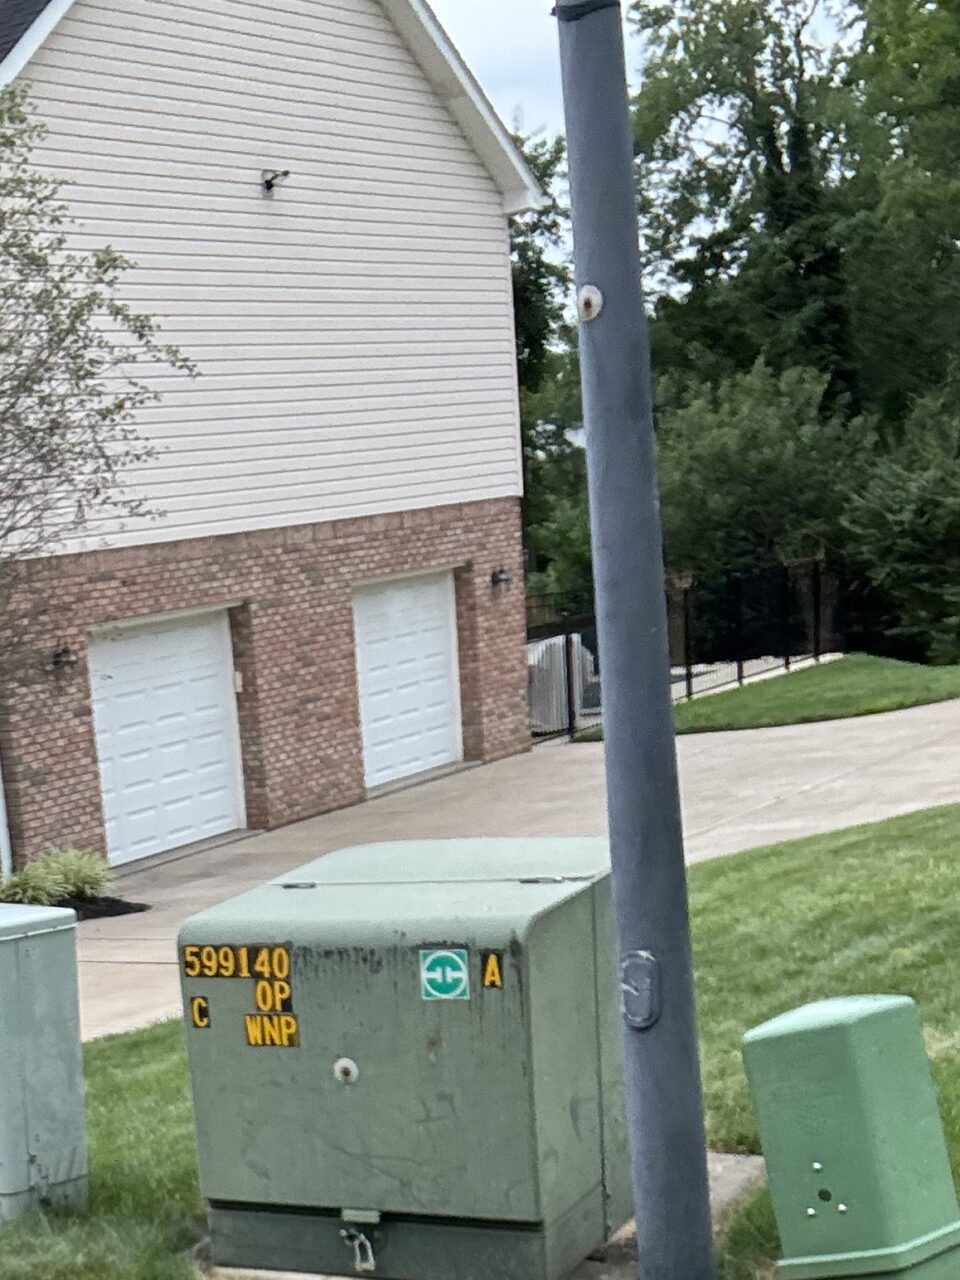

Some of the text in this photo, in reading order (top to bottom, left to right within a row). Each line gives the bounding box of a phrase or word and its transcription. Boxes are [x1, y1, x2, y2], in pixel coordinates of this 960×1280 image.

[184, 946, 289, 979] 599140
[483, 953, 502, 988] A
[192, 996, 209, 1028] C
[245, 1014, 298, 1046] WNP
